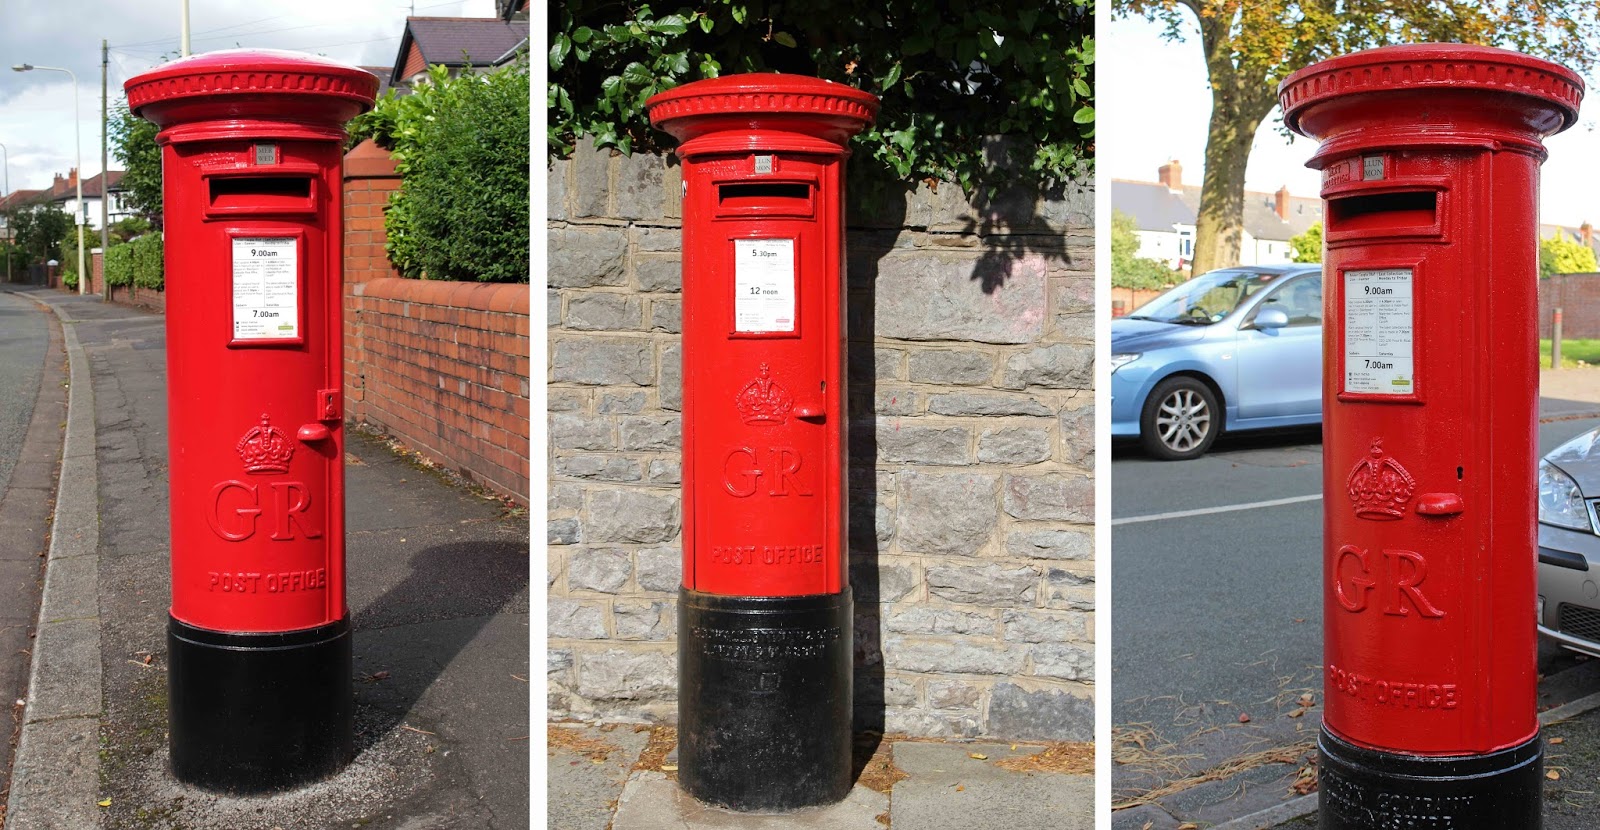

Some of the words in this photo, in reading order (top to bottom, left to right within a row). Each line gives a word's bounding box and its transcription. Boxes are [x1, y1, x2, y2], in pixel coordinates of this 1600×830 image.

[1364, 159, 1384, 167] LLUN
[1364, 169, 1383, 177] MON
[251, 248, 278, 257] 9.00am
[752, 249, 777, 258] 5.30pm
[750, 286, 761, 295] 12
[1364, 285, 1393, 295] 9.00am
[252, 309, 280, 318] 7.00am
[1364, 359, 1394, 369] 7.00am
[721, 446, 814, 499] GR
[205, 479, 323, 543] GR
[712, 545, 756, 565] POST
[762, 544, 824, 565] OFFICE
[208, 571, 261, 594] POST
[266, 567, 327, 593] OFFICE
[1332, 544, 1446, 619] GR
[1330, 664, 1371, 700] POST
[1375, 680, 1458, 710] OFFICE
